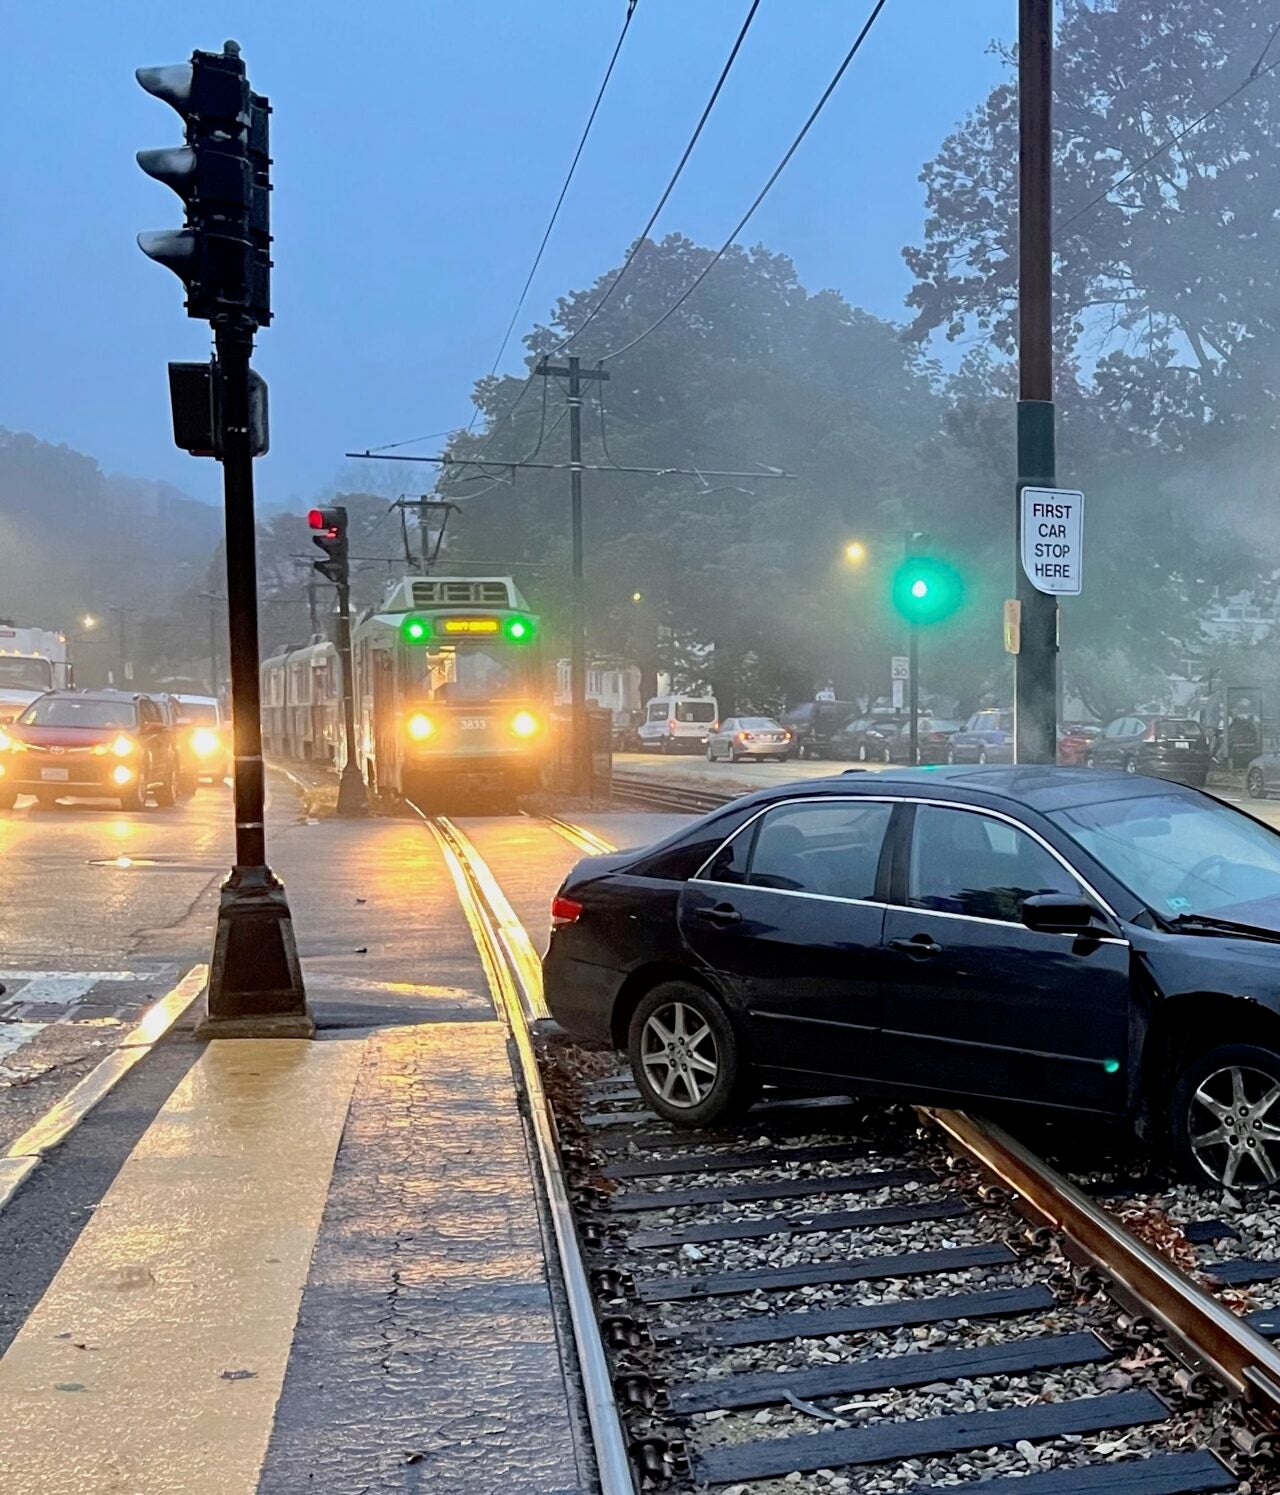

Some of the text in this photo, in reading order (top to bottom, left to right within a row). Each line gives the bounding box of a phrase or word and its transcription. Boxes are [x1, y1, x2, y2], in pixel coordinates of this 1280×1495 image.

[1033, 503, 1072, 519] FIRST
[1038, 523, 1066, 538] CAR
[1034, 543, 1070, 558] STOP
[1035, 563, 1070, 578] HERE
